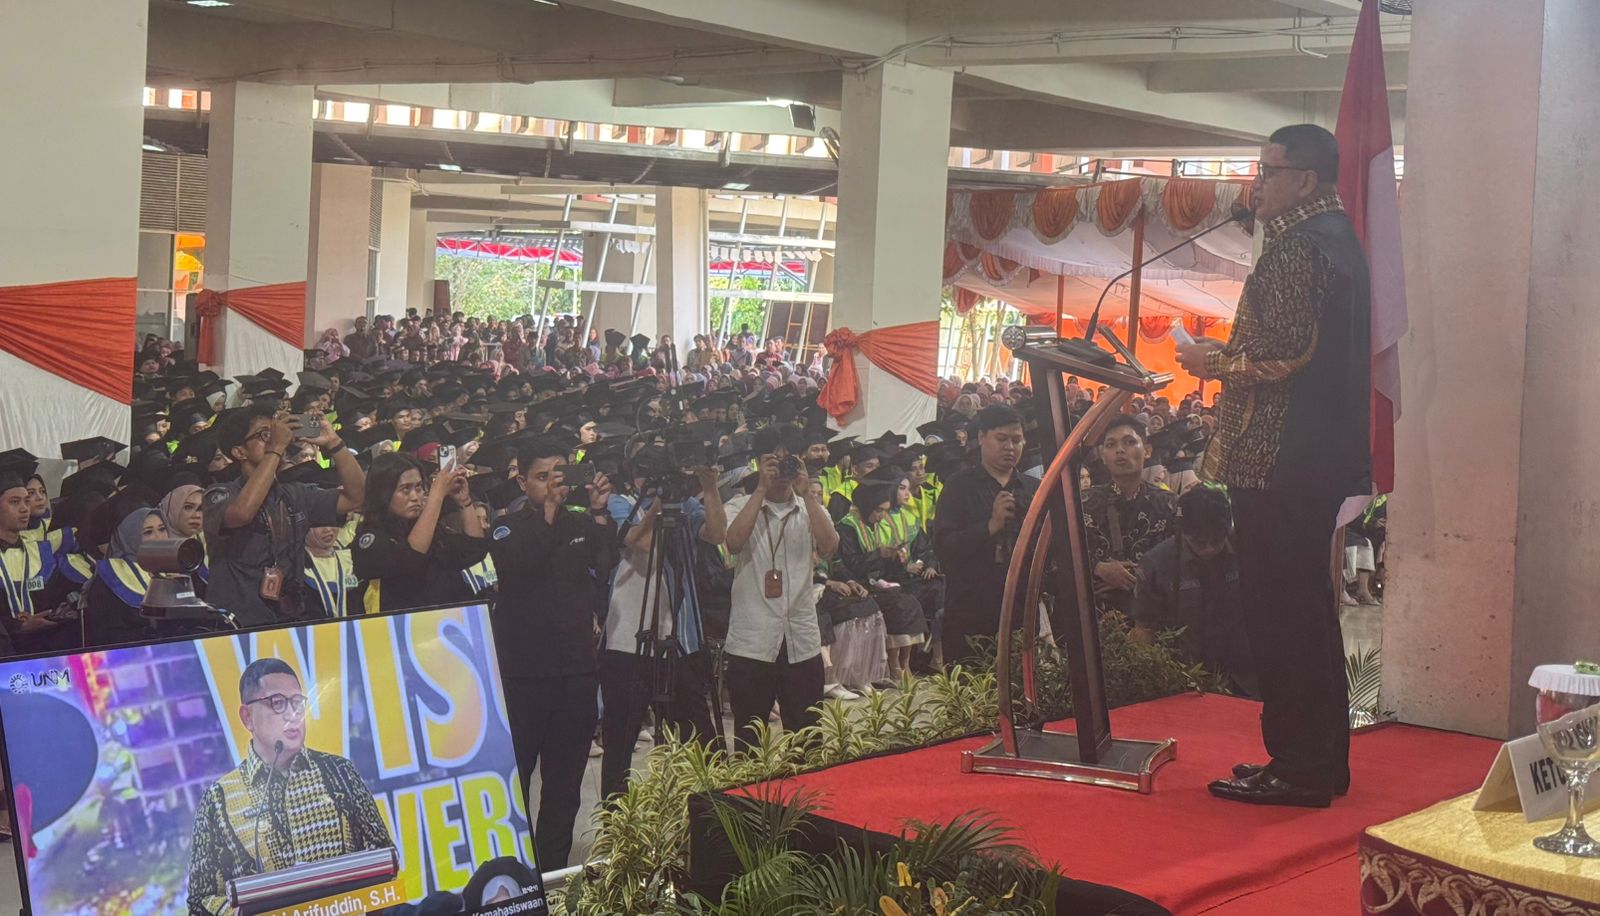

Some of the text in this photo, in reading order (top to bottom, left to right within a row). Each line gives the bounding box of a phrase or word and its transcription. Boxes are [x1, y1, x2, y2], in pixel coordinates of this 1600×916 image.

[30, 668, 71, 688] UNM
[194, 604, 512, 779] WIS
[370, 886, 400, 906] S.H.
[472, 897, 544, 916] mahasiswaan
